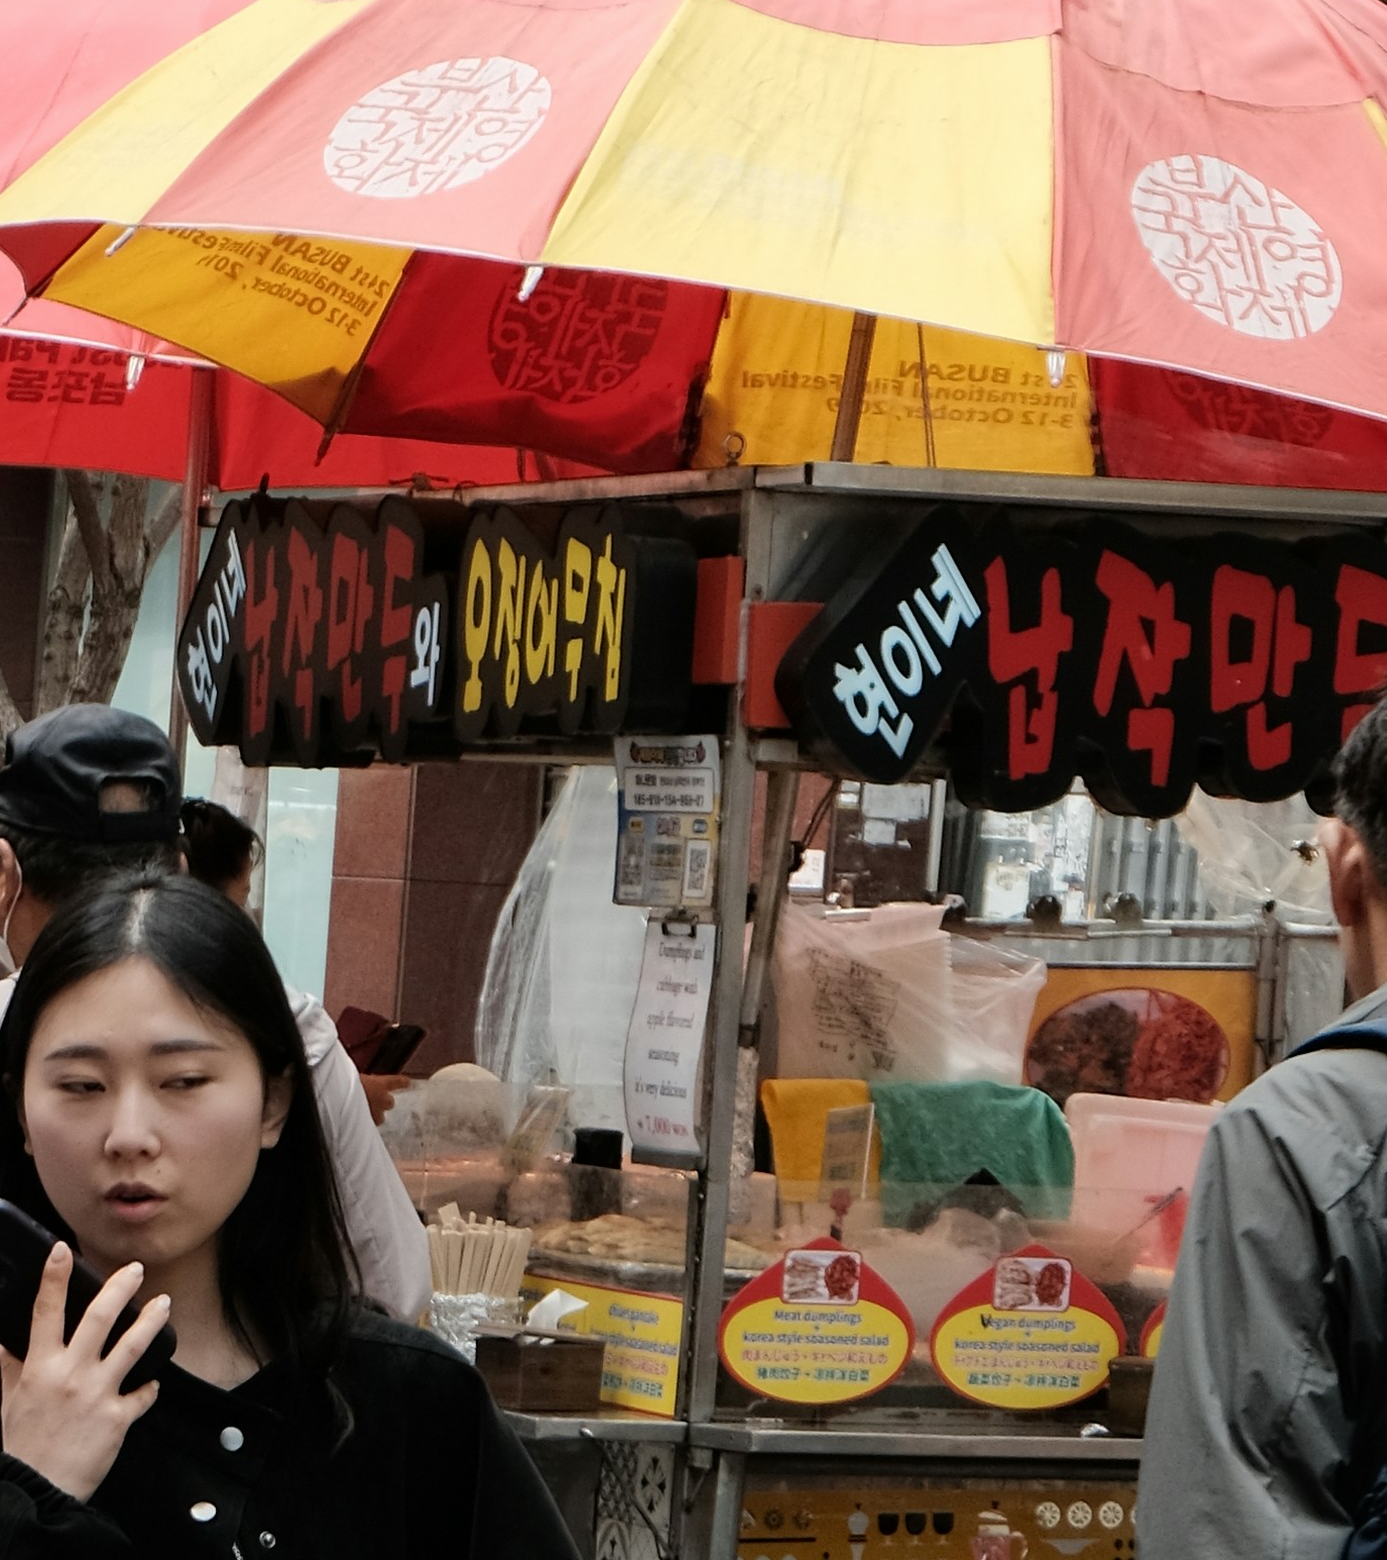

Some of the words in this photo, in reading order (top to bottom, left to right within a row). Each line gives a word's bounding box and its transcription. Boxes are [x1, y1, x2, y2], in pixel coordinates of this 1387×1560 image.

[463, 532, 626, 714] 오징어무침
[832, 542, 982, 759] 현이네
[774, 1310, 802, 1322] Meat
[803, 1310, 863, 1326] dumplings
[980, 1313, 1017, 1330] Vegan
